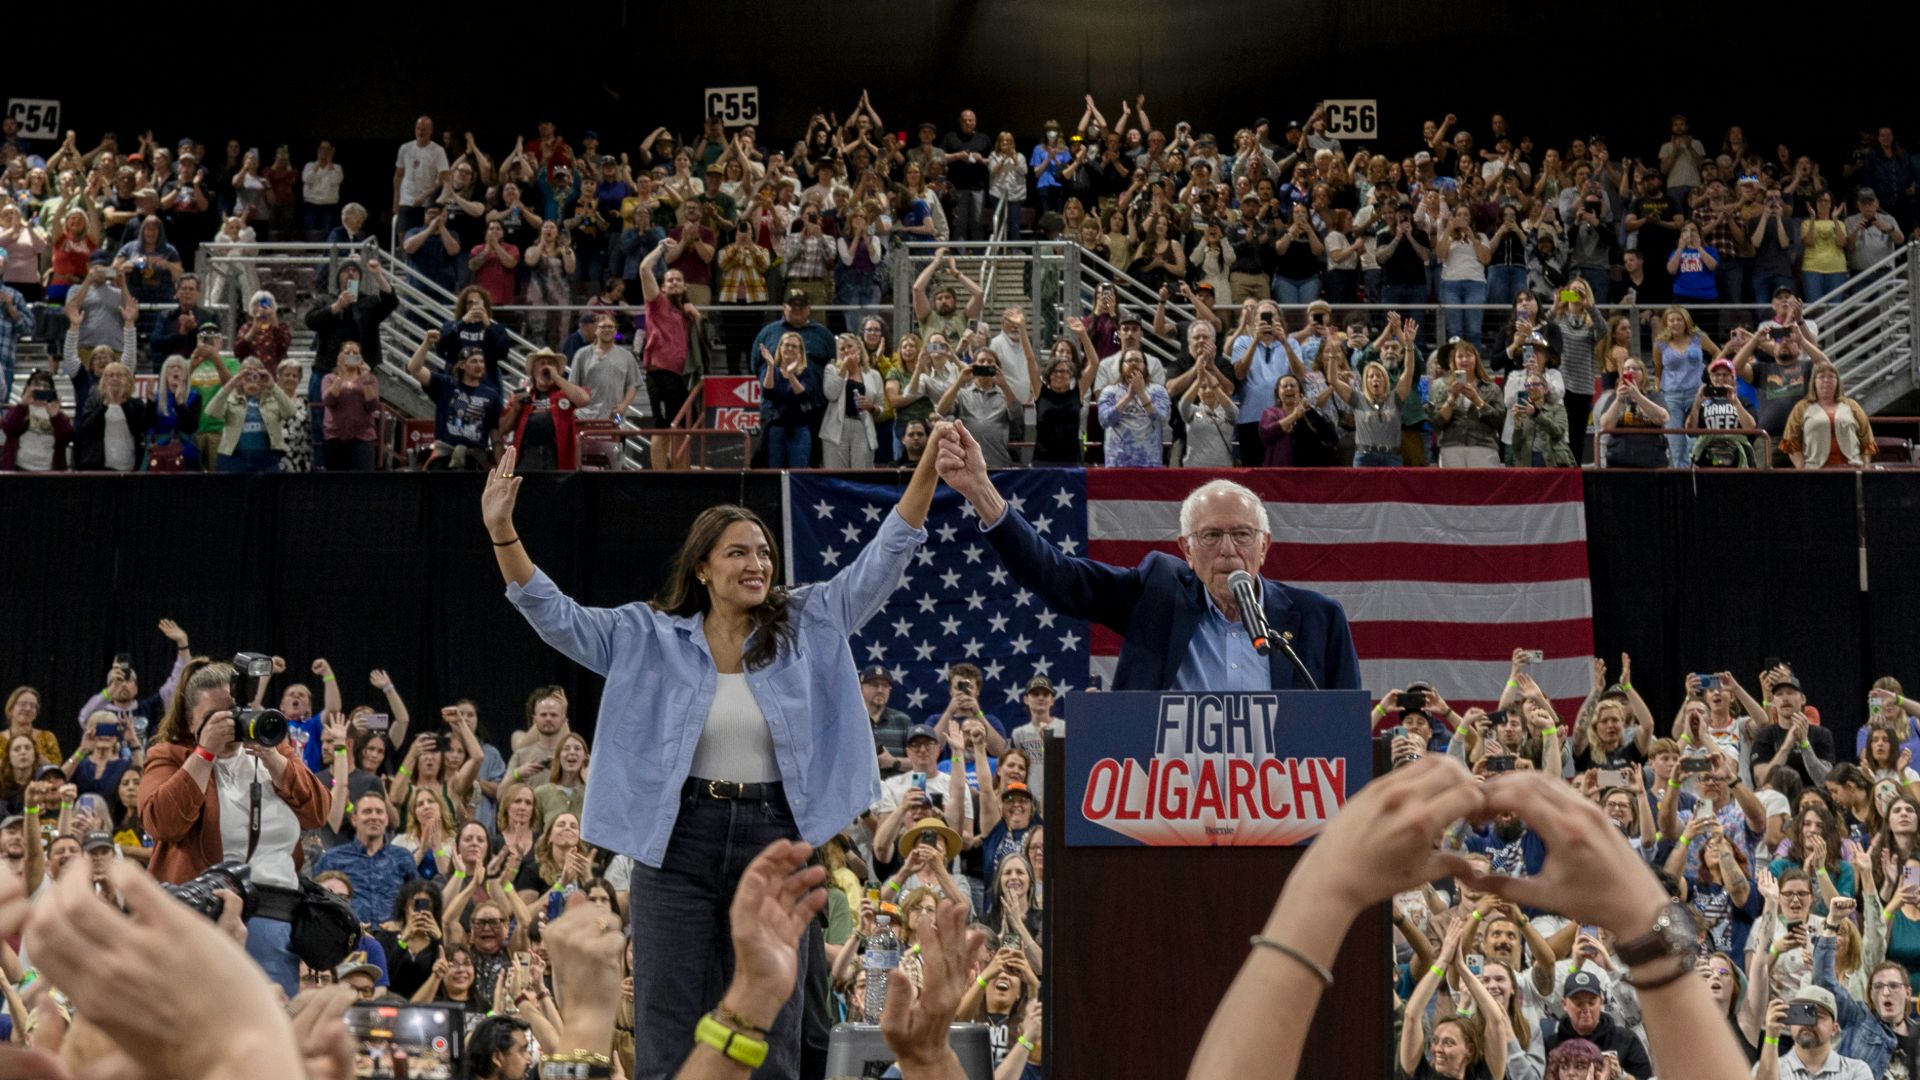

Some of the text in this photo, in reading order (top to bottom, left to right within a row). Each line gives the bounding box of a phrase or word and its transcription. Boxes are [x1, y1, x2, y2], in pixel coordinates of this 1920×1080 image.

[10, 102, 58, 133] C54
[708, 93, 757, 120] C55
[1326, 104, 1376, 134] C56
[1704, 403, 1738, 417] HANDS
[1155, 694, 1279, 754] FIGHT
[1082, 757, 1347, 821] OLIGARCHY
[1204, 826, 1235, 836] Bernie
